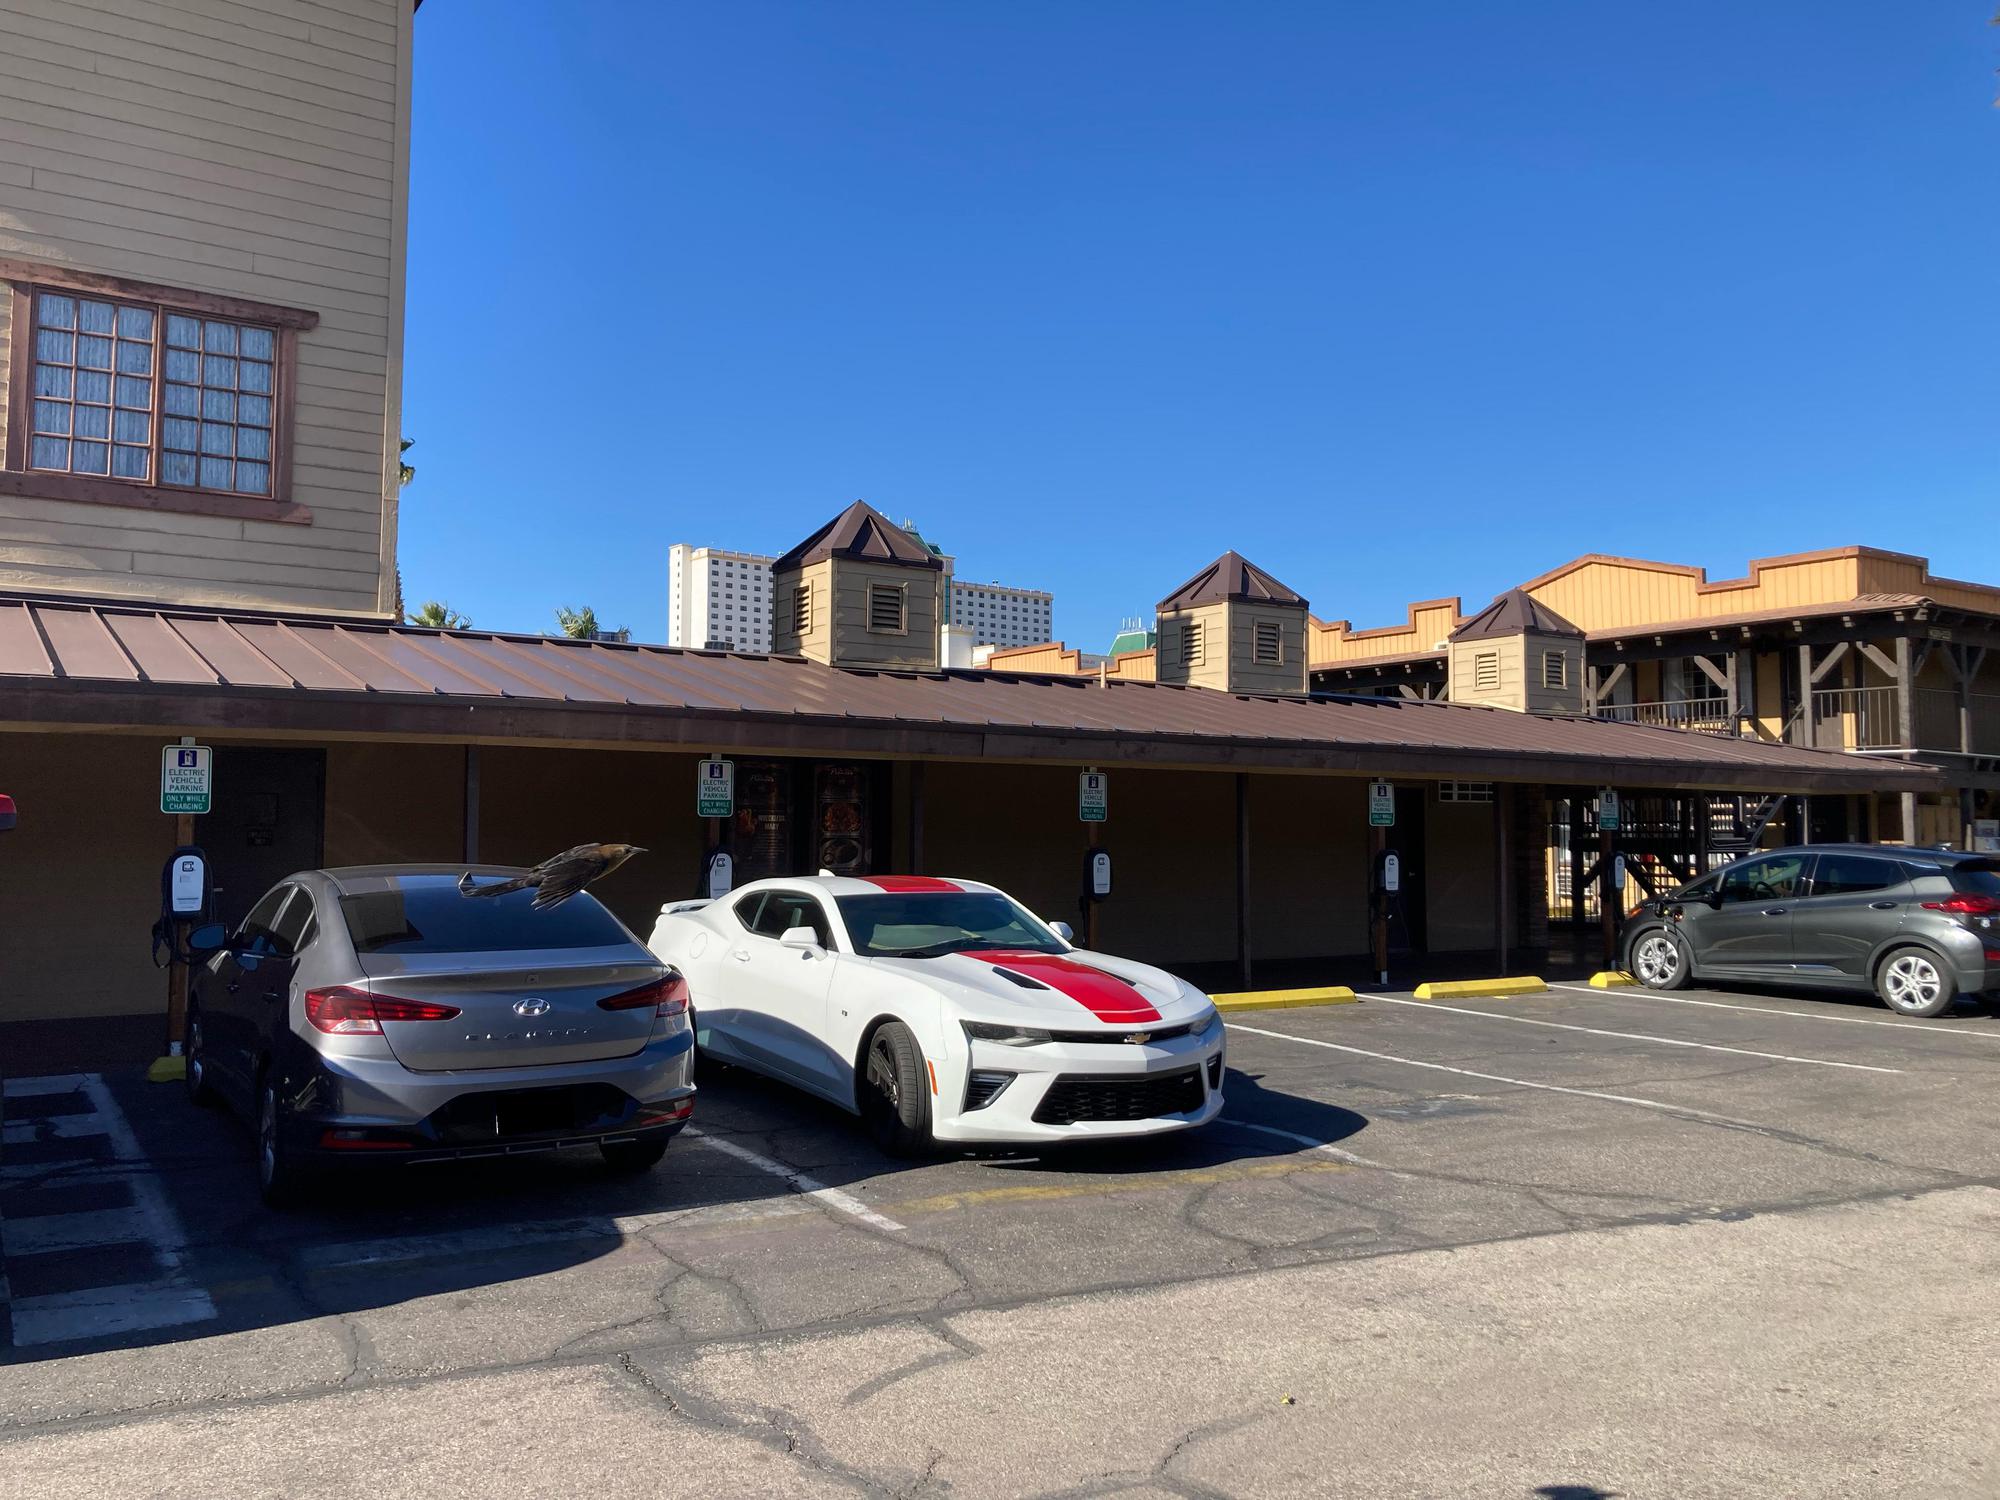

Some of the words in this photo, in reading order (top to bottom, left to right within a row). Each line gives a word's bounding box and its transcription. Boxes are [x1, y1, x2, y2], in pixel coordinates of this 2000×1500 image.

[168, 768, 205, 776] ELECTRIC
[170, 776, 203, 784] VEHICLE
[169, 784, 204, 792] PARKING
